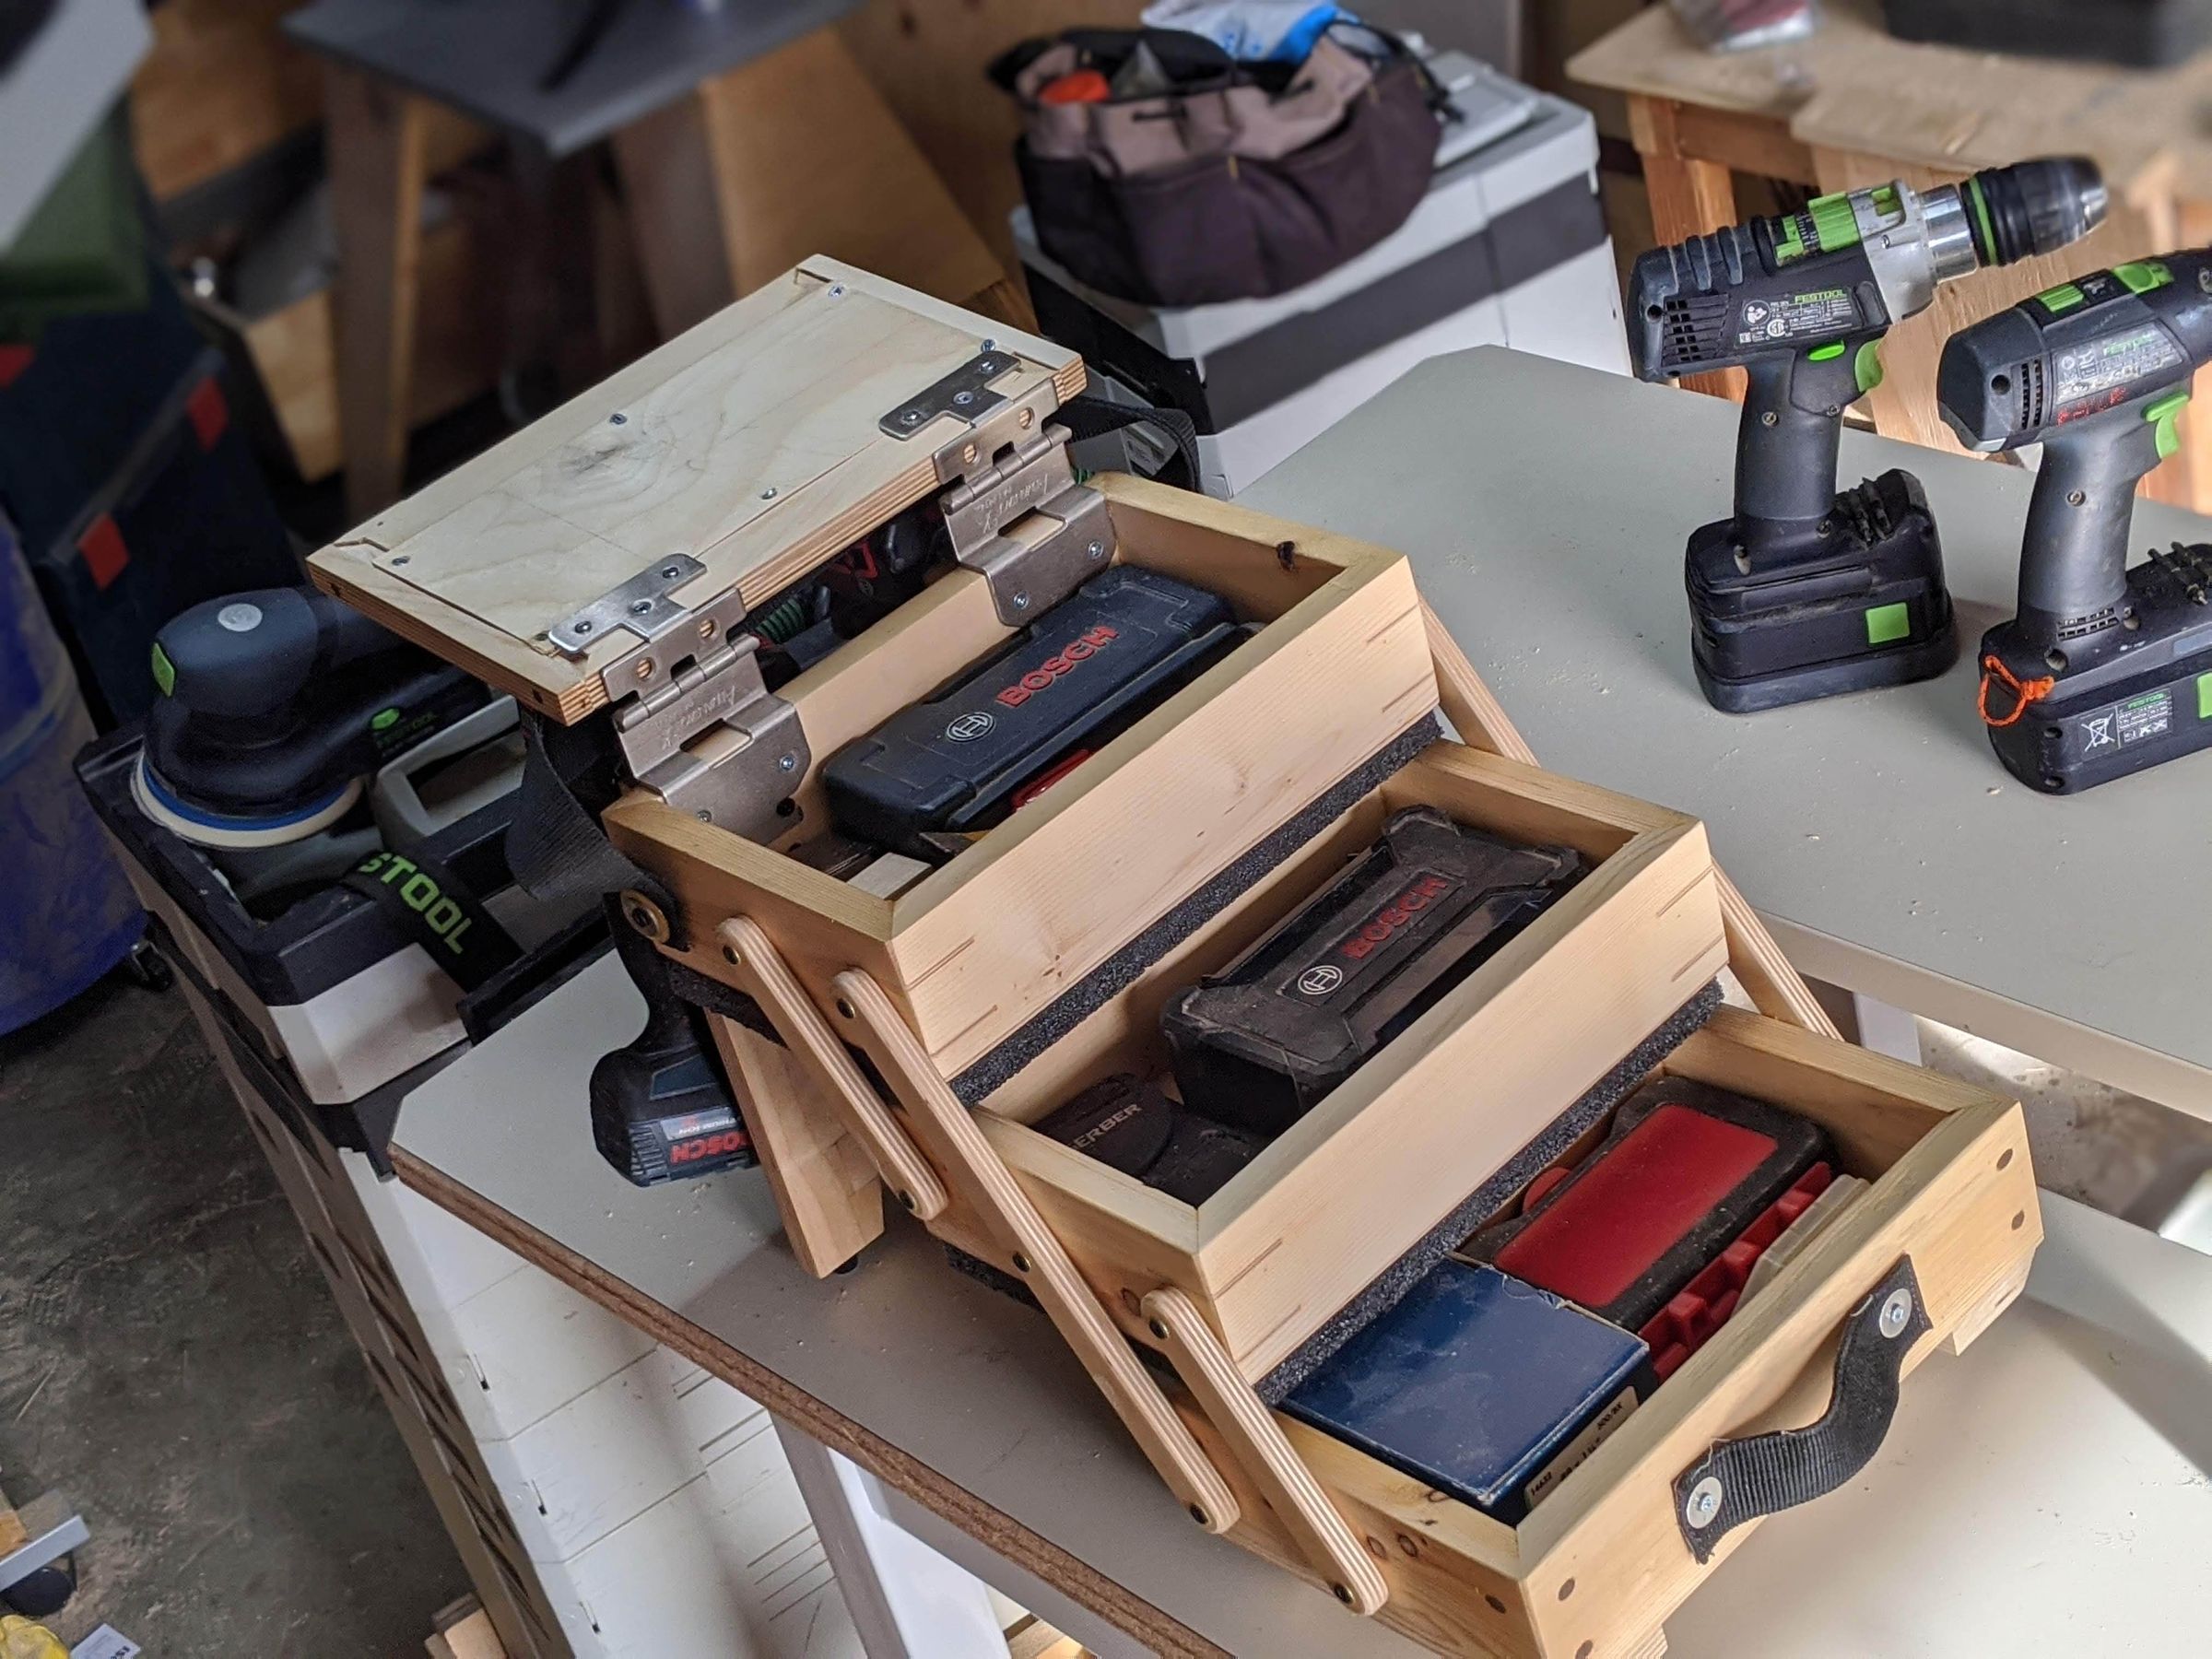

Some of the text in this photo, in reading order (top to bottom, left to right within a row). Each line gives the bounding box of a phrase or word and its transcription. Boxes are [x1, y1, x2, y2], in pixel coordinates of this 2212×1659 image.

[1794, 288, 1846, 305] FESTOOL
[994, 625, 1120, 709] BOSCH
[1341, 877, 1449, 959] BOSCH
